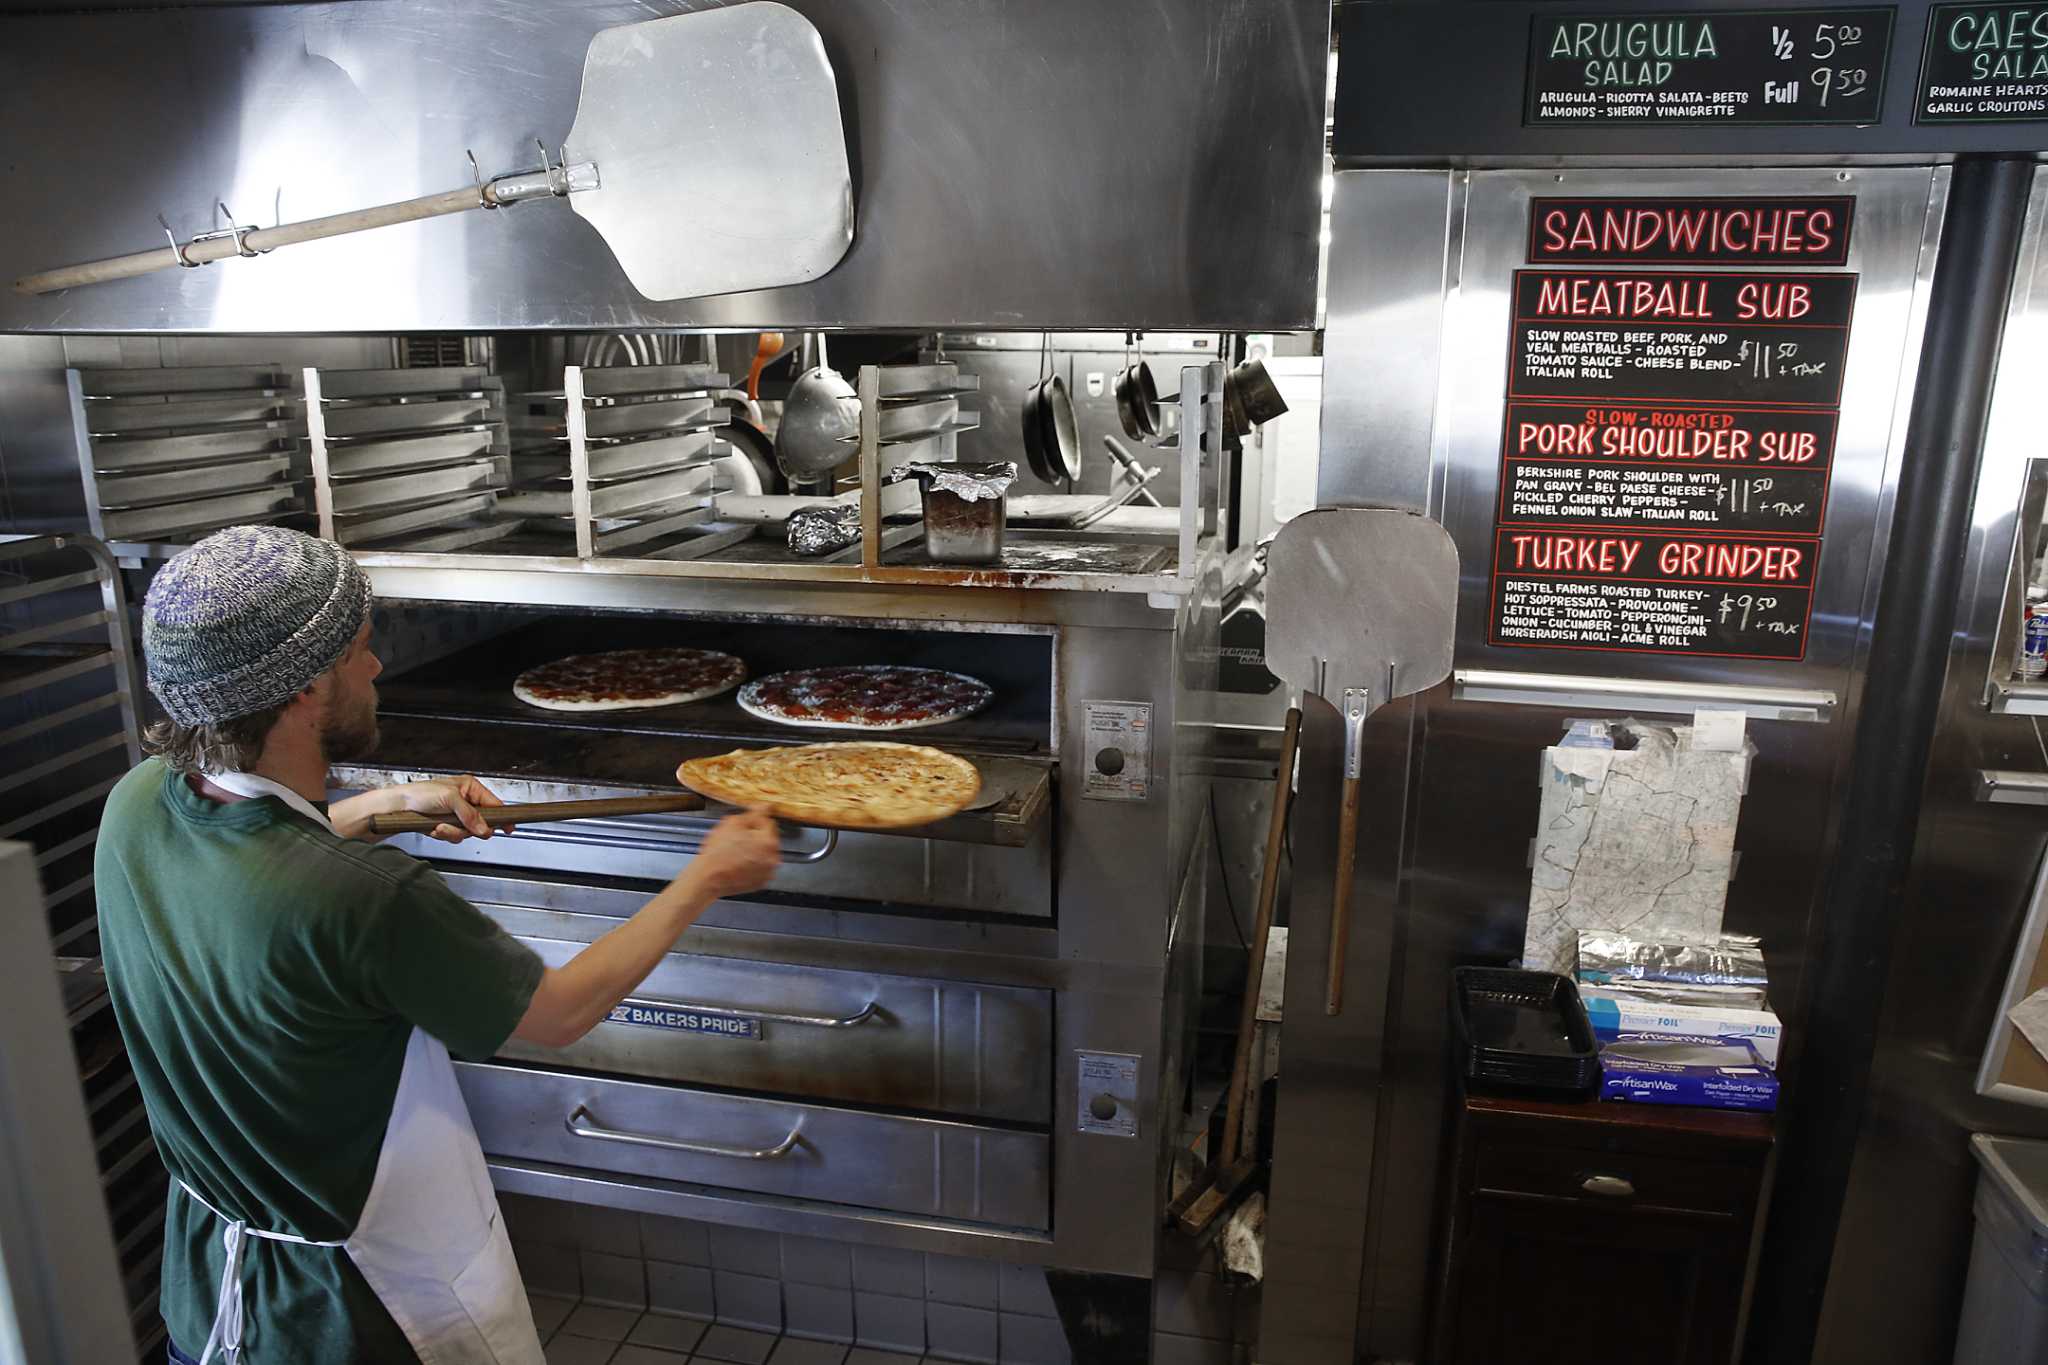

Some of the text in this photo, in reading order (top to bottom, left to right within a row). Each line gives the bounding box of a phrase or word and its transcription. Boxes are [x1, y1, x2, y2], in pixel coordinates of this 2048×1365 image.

[1551, 23, 1716, 57] ARUGULA
[1585, 60, 1672, 86] SALAD
[1765, 81, 1798, 104] Full
[1930, 86, 1992, 97] ROMAINE
[1541, 107, 1595, 117] ALMONDS
[1607, 106, 1650, 116] SHERRY
[1656, 106, 1735, 116] VINAIGRETTE
[1928, 100, 2045, 113] GARLIC CROUTONS
[1545, 210, 1832, 251] SANDWICHES
[1537, 279, 1812, 318] MEATBALL SUB
[1528, 330, 1728, 345] SLOW ROASTED BEEF, PORK, AND
[1527, 343, 1556, 353] VEAL
[1562, 344, 1631, 354] MEATBALLS
[1647, 346, 1706, 357] ROASTED
[1526, 354, 1576, 365] TOMATO
[1581, 356, 1622, 366] SAUCE
[1635, 358, 1683, 369] CHEESE
[1526, 366, 1612, 379] ITALIAN ROLL
[1519, 423, 1816, 462] PORK SHOULDER SUB
[1517, 467, 1720, 484] BERKSHIRE PORK SHOULDER WITH
[1516, 480, 1537, 490] PAN
[1544, 481, 1582, 491] GRAVY
[1595, 483, 1615, 492] BEL
[1621, 484, 1656, 494] PAESE
[1514, 492, 1563, 502] PICKLED
[1569, 494, 1615, 504] CHERRY
[1623, 495, 1677, 506] PEPPERS
[1513, 504, 1557, 515] FENNEL
[1562, 506, 1595, 516] ONION
[1601, 507, 1633, 518] SLAW
[1643, 509, 1689, 519] ITALIAN
[1690, 510, 1718, 521] ROLL
[1772, 503, 1804, 516] TAX
[1512, 537, 1802, 579] TURKEY GRINDER
[1507, 582, 1553, 593] DIESTEL
[1556, 584, 1597, 594] FARMS
[1602, 586, 1650, 597] ROASTED
[1505, 593, 1525, 604] HOT
[1530, 595, 1607, 608] SOPPRESSATA
[1619, 599, 1688, 612] PROVOLONE
[1504, 606, 1554, 616] LETTUCE
[1565, 608, 1611, 619] TOMATO
[1503, 617, 1538, 626] ONION
[1549, 619, 1611, 630] CUCUMBER
[1622, 624, 1641, 633] OIL
[1655, 625, 1707, 636] VINEGAR
[1768, 622, 1799, 634] TAX
[1501, 628, 1577, 640] HORSERADISH
[1581, 631, 1609, 642] AIOLI
[1620, 633, 1653, 644] ACME
[1660, 635, 1690, 645] ROLL
[632, 1009, 749, 1033] BAKERS PRIDE
[1658, 1018, 1679, 1027] FOIL
[1755, 1025, 1776, 1034] FOIL
[1743, 1085, 1756, 1093] Dry
